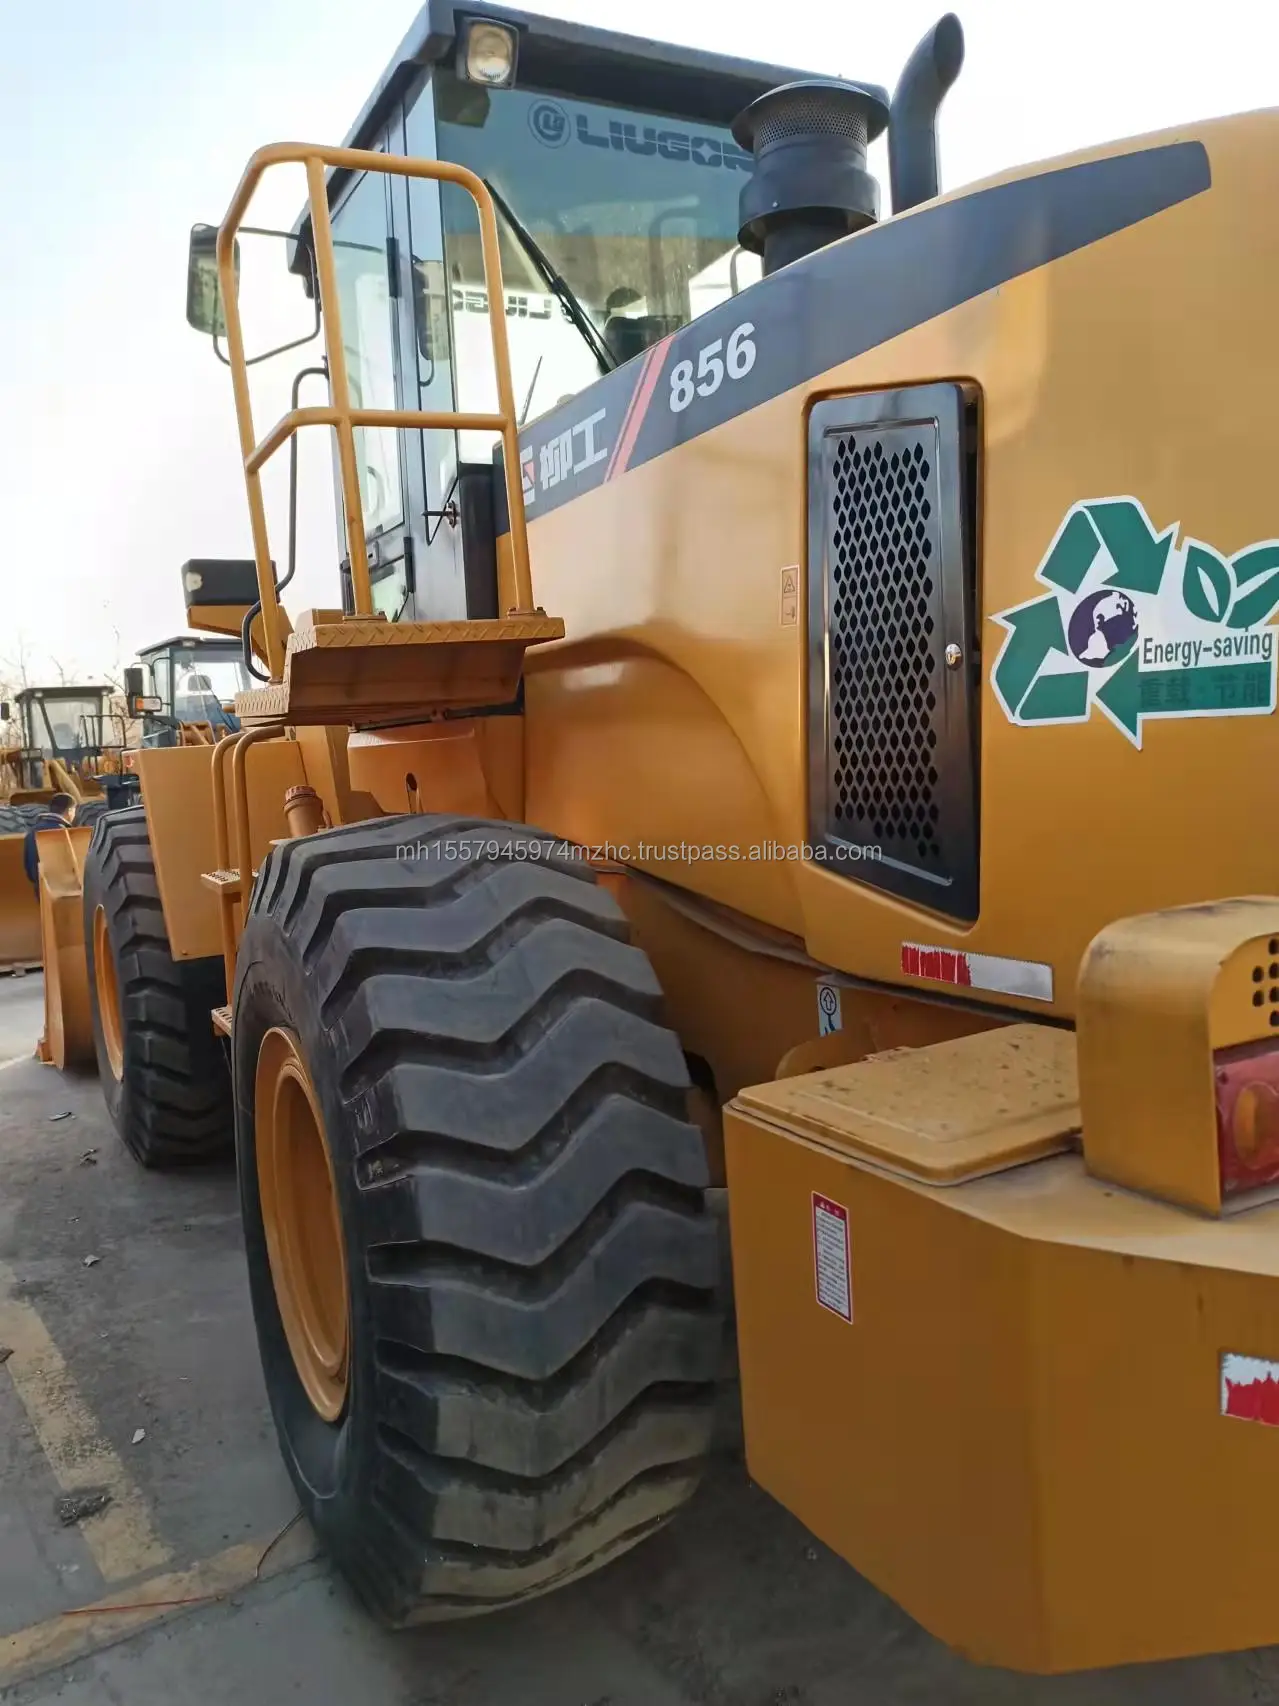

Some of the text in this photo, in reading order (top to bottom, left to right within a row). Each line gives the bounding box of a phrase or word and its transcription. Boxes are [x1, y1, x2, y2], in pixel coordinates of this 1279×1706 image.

[576, 114, 755, 173] LIUGON
[669, 322, 757, 413] 856
[539, 408, 608, 491] 柳工
[1143, 632, 1273, 667] Energy-saving
